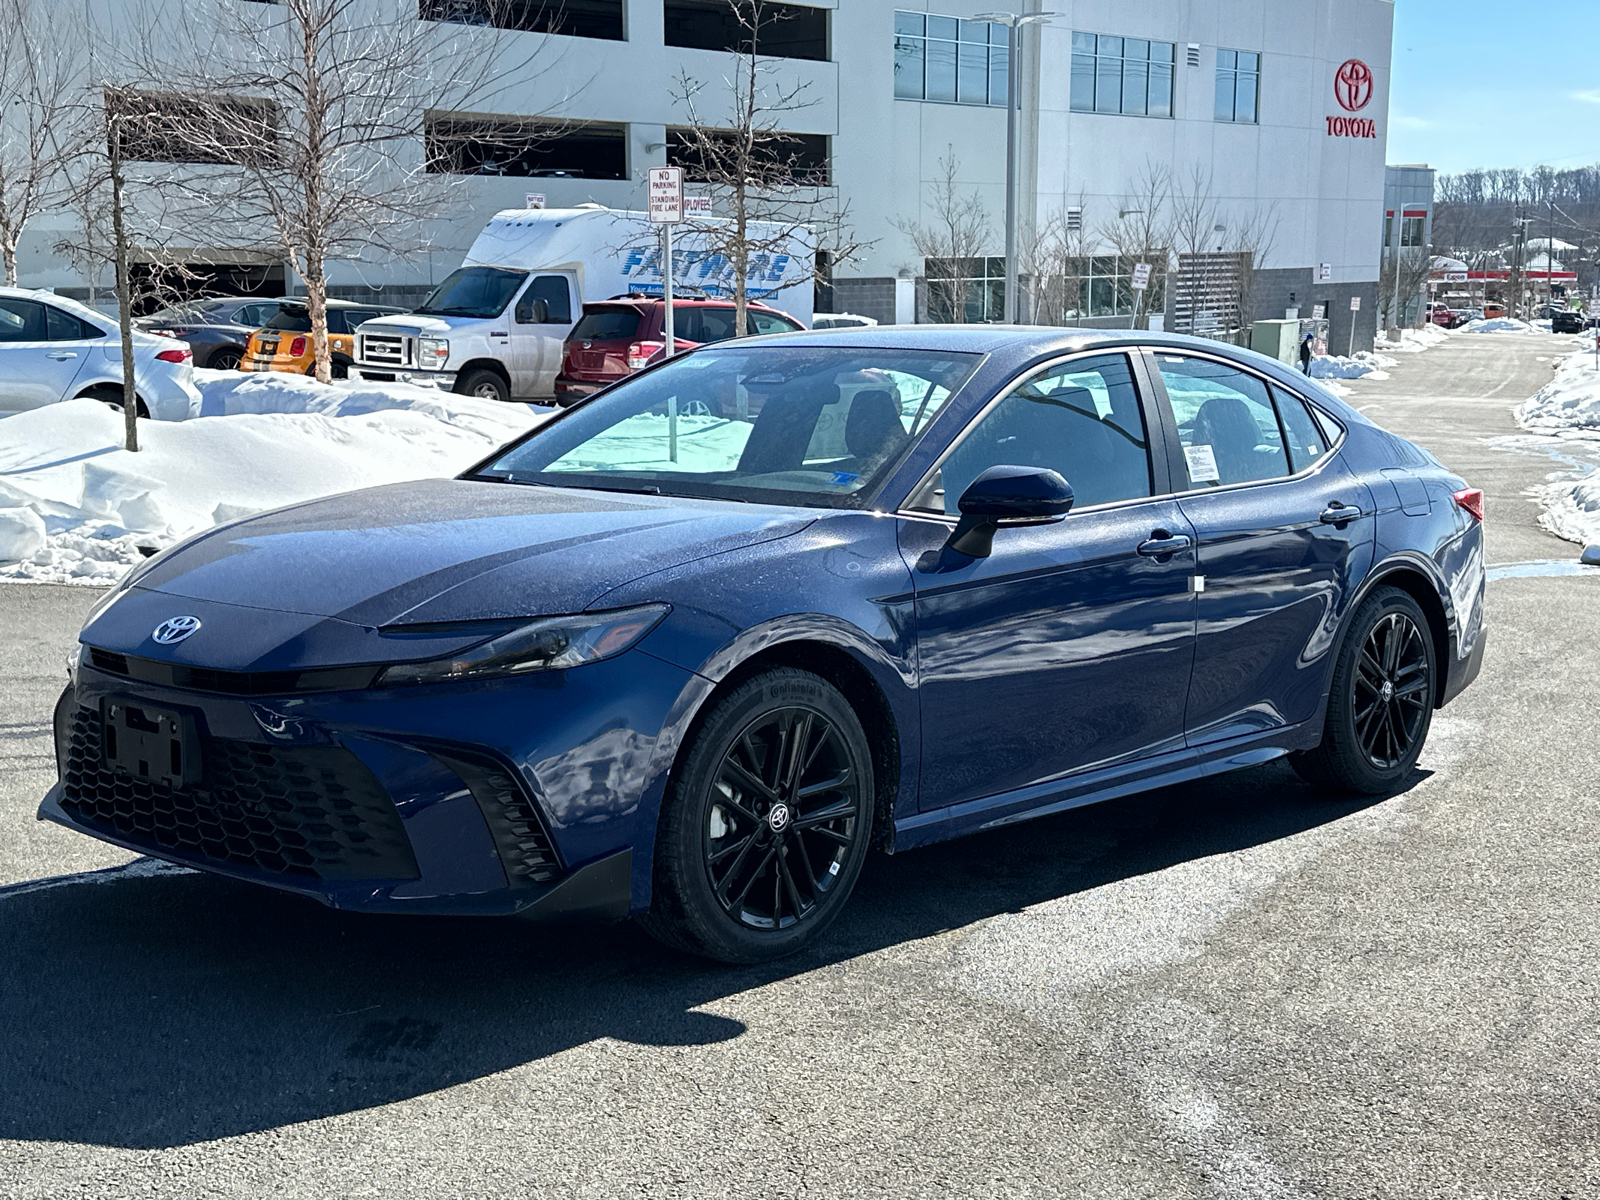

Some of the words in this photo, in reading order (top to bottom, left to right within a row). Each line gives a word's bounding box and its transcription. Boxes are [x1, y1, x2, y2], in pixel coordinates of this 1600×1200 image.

[1326, 116, 1376, 138] TOYOTA
[659, 171, 670, 181] NO
[684, 199, 711, 211] MPLOYEES
